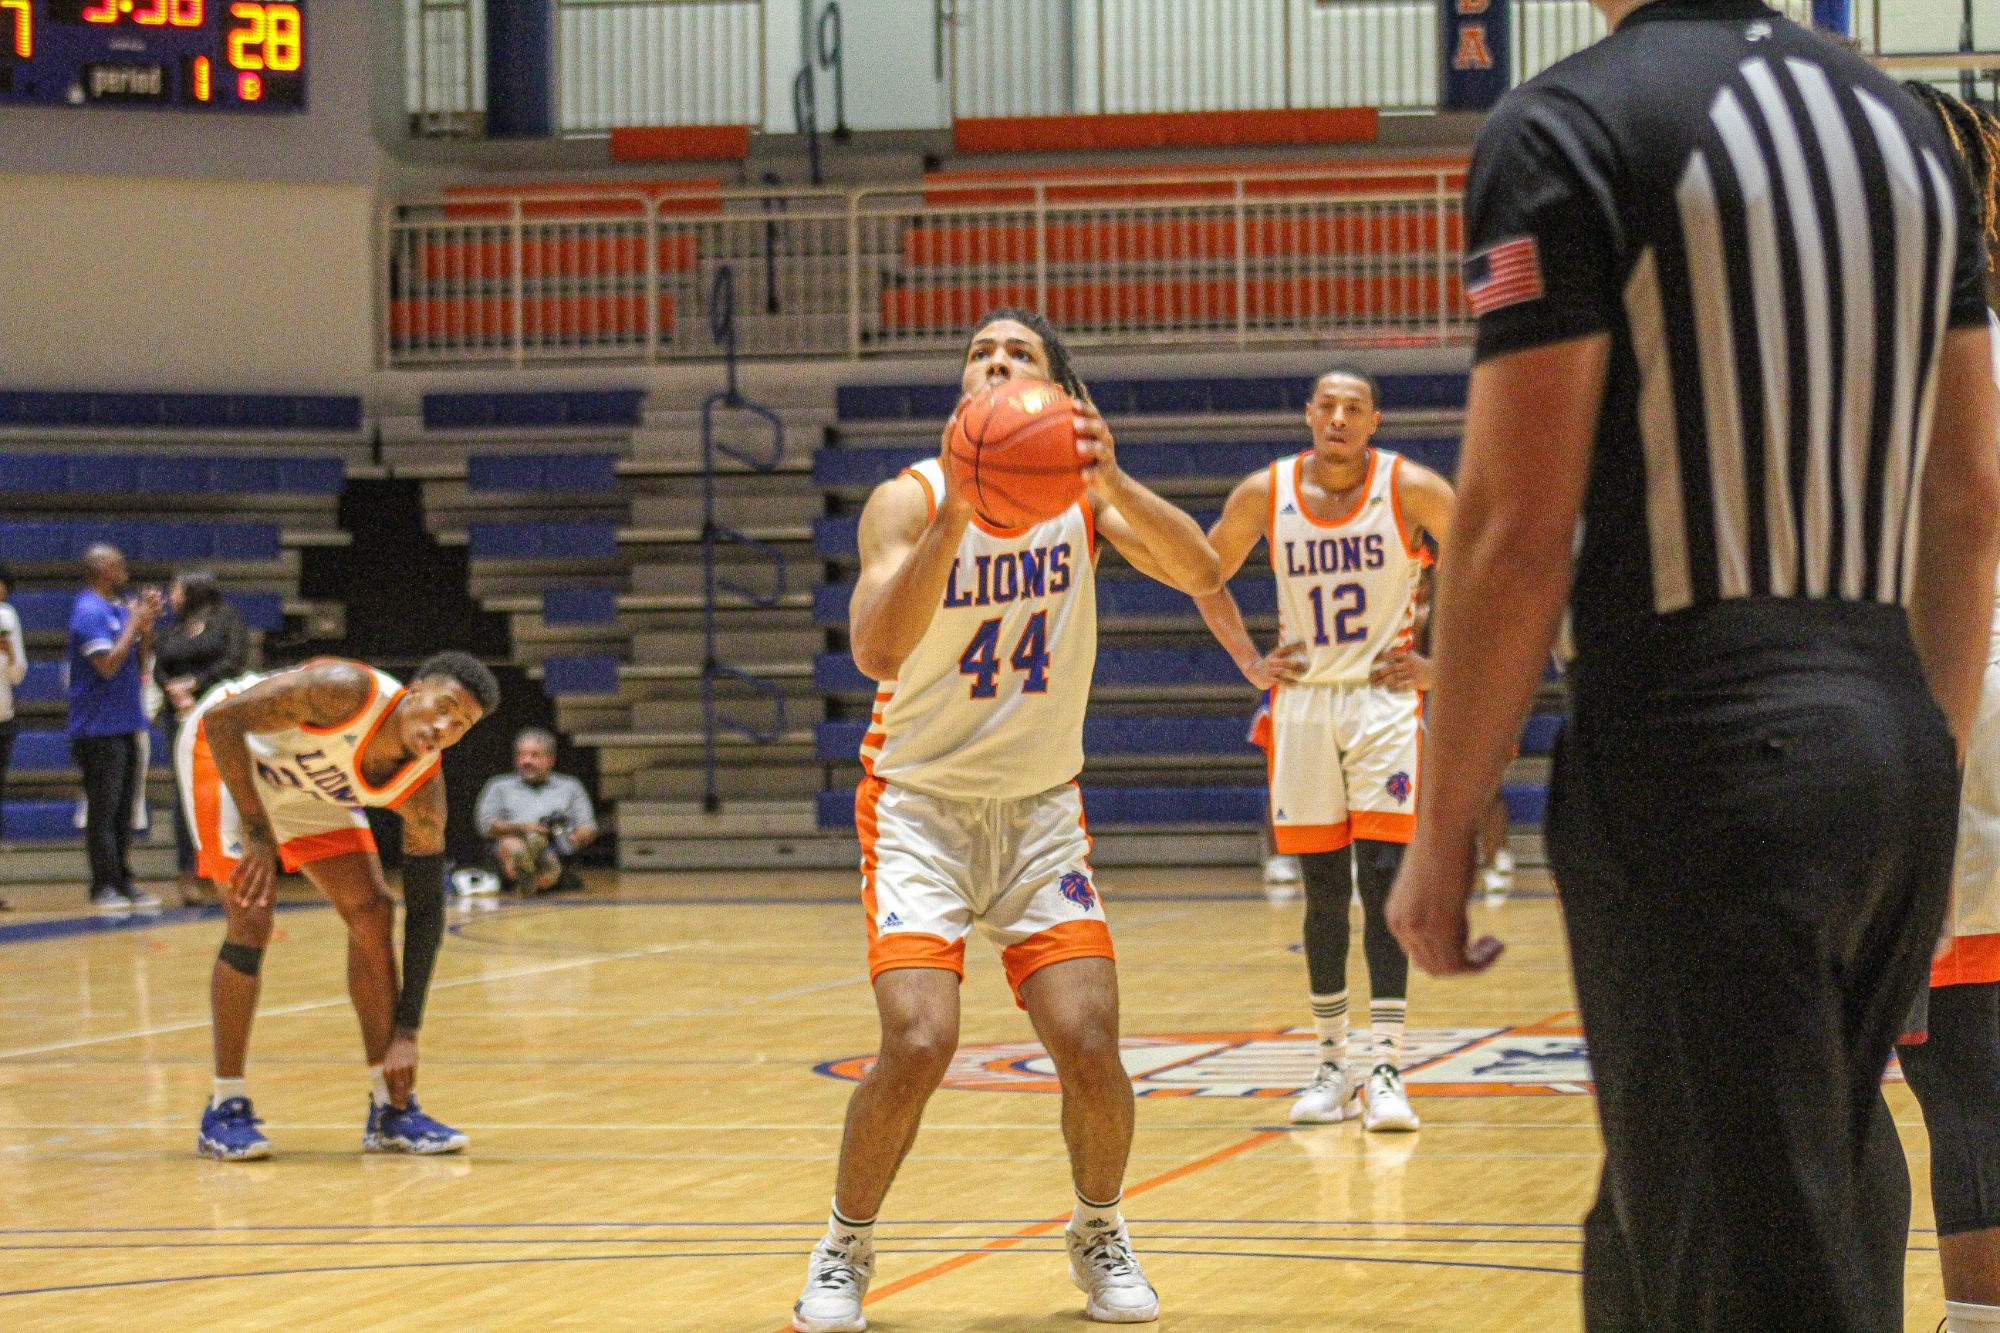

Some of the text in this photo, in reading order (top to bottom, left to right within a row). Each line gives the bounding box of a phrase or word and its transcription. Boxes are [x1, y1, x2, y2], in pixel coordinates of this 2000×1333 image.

[228, 2, 301, 70] 28
[193, 55, 211, 101] 1
[943, 542, 1072, 609] LIONS
[1284, 534, 1385, 577] LIONS
[1308, 582, 1369, 646] 12
[958, 609, 1051, 700] 44
[295, 749, 361, 805] LION
